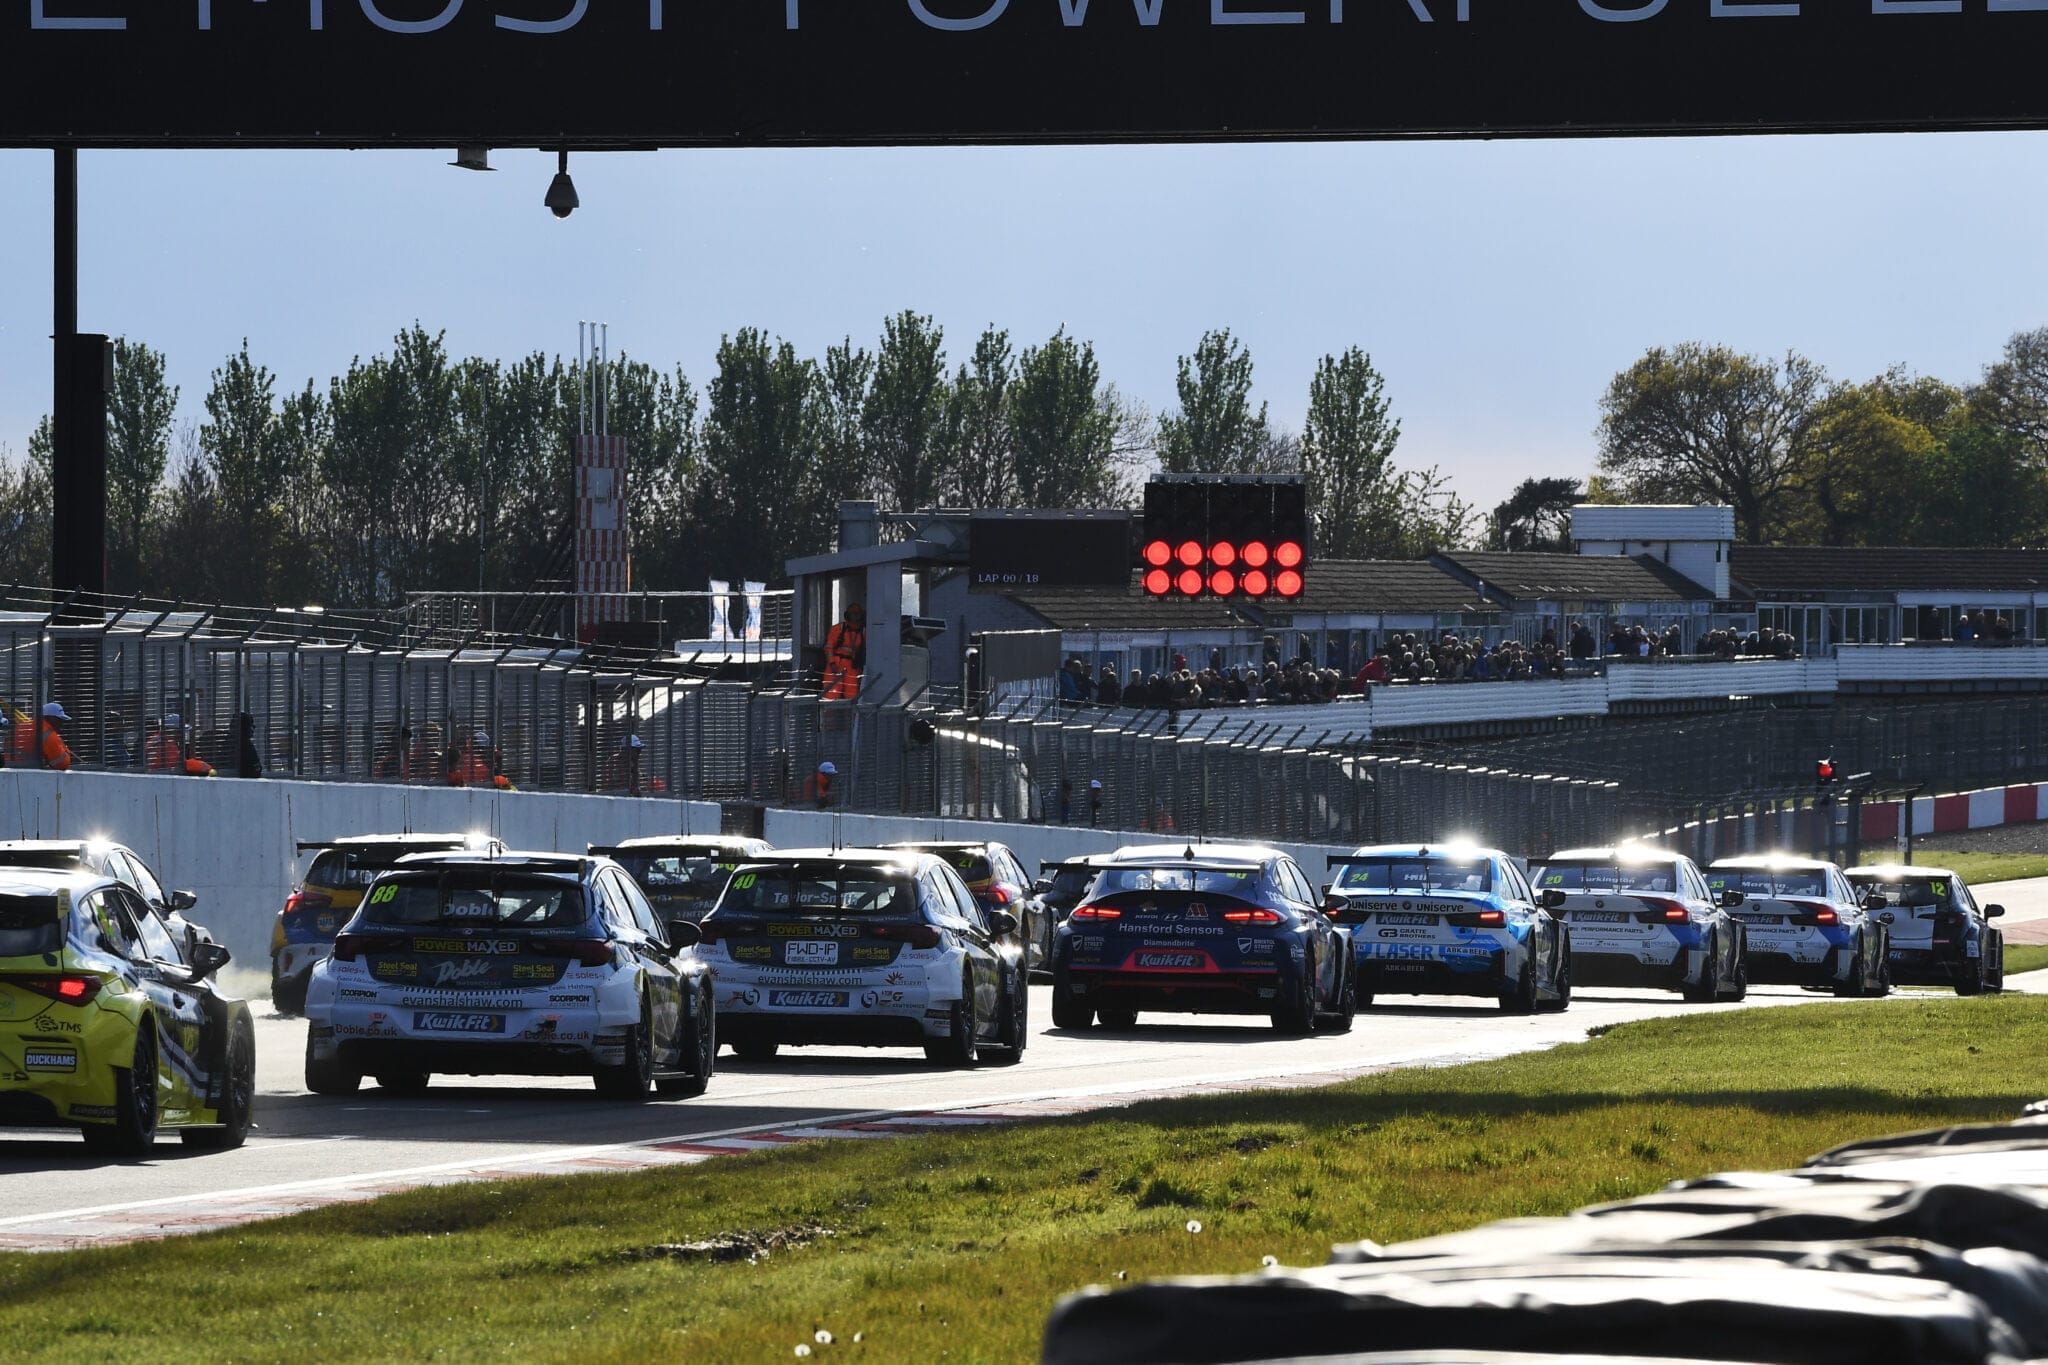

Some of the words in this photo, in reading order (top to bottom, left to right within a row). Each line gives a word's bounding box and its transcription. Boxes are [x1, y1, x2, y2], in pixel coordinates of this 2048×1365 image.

[978, 574, 999, 583] LAP
[1003, 574, 1016, 583] 00
[1026, 574, 1039, 583] 18
[732, 873, 757, 890] 40
[1350, 872, 1369, 882] 24
[1545, 875, 1562, 884] 20
[370, 884, 399, 905] 88
[1930, 881, 1945, 896] 12
[769, 925, 810, 936] POWER
[1119, 923, 1172, 934] Hansford
[1176, 923, 1224, 935] Sensors
[415, 939, 465, 951] POWER
[787, 943, 836, 955] FWD-IP
[1143, 939, 1195, 947] Diamondbrite
[1376, 944, 1434, 960] LASER
[758, 973, 862, 986] evanshalshaw.com
[340, 989, 377, 998] SCORPION
[402, 995, 523, 1008] evanshalshaw.com
[60, 1021, 82, 1033] TMS
[26, 1054, 76, 1065] DUCKHAMS
